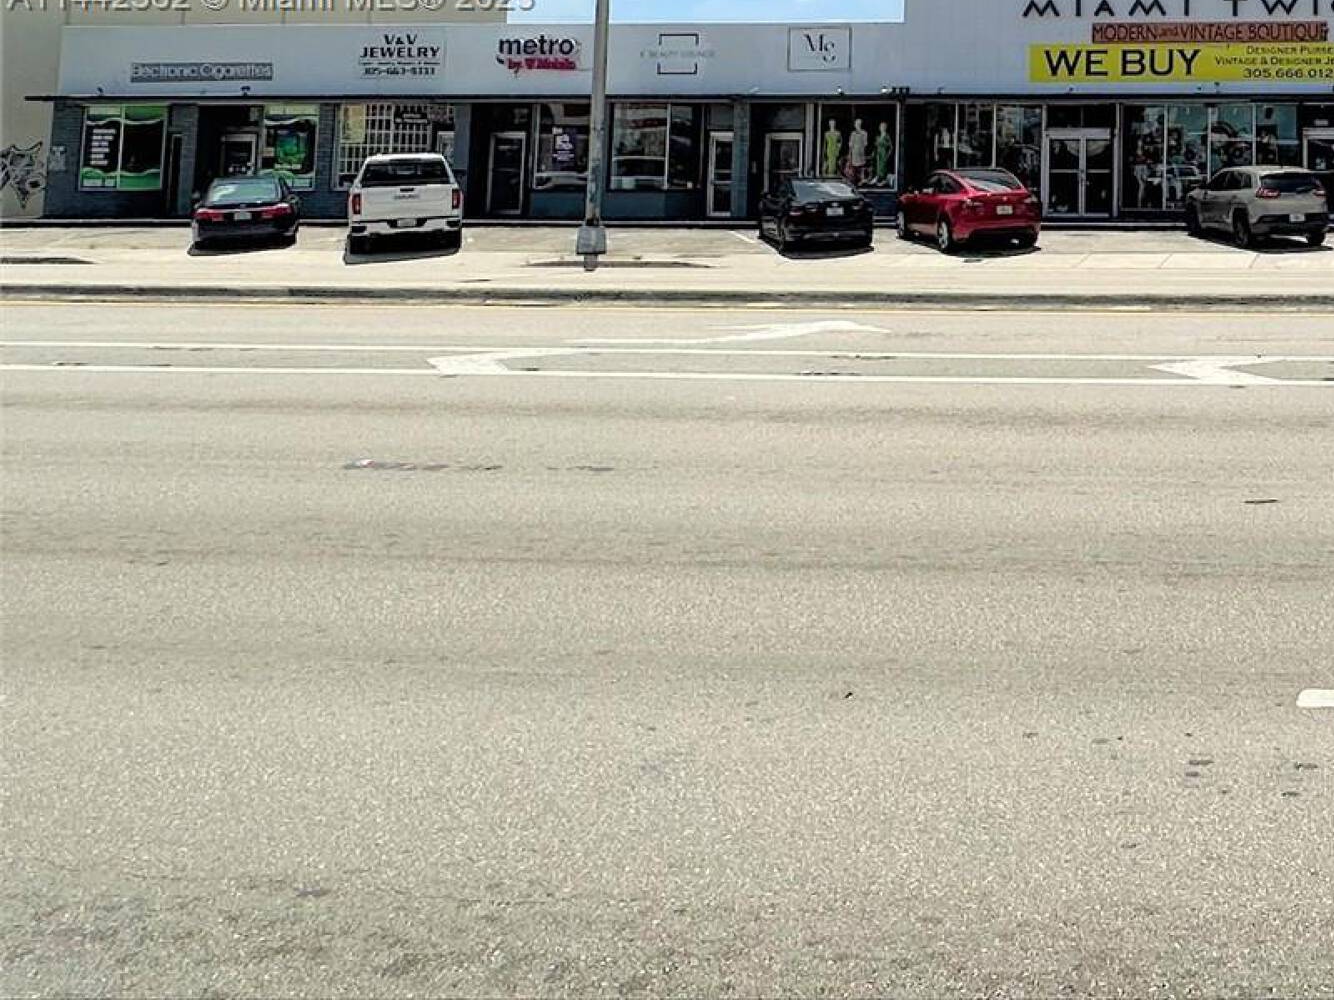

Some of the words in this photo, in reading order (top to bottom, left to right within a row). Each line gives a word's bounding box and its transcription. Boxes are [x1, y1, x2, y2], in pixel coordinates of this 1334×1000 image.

[1093, 24, 1157, 42] MODERN
[1180, 23, 1245, 41] VINTAGE
[360, 46, 440, 58] JEWELRY
[499, 35, 575, 55] metro
[1246, 45, 1297, 55] DESIGNER
[1044, 49, 1109, 77] WE
[1121, 49, 1202, 77] BUY
[1215, 56, 1260, 66] VINTAGE
[1270, 56, 1322, 66] DESIGNER
[200, 63, 273, 79] Cigarettes
